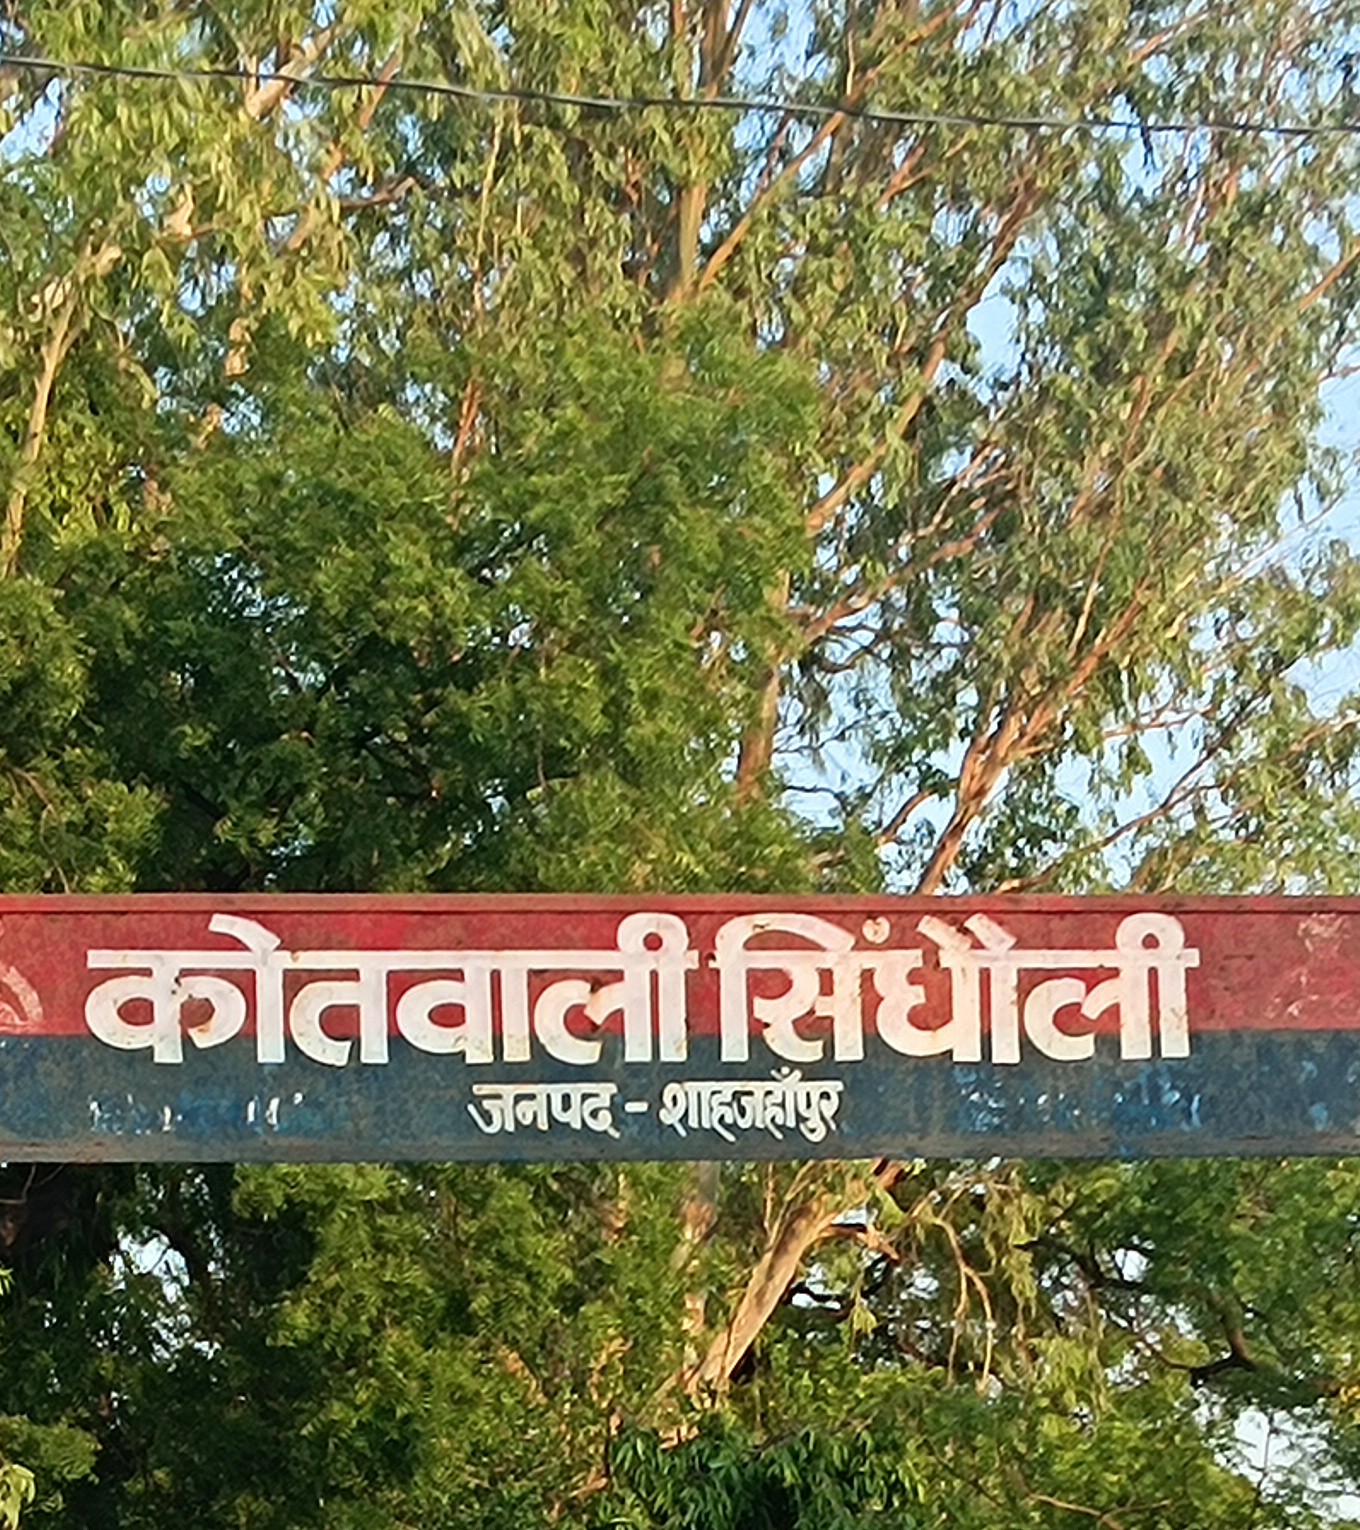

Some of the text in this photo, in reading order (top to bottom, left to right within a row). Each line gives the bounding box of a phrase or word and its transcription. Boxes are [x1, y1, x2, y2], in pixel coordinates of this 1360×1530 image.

[84, 912, 1200, 1066] कोतवाली सिंधौली
[468, 1083, 619, 1138] जनपद
[658, 1066, 842, 1142] शाहजहाँपुर
